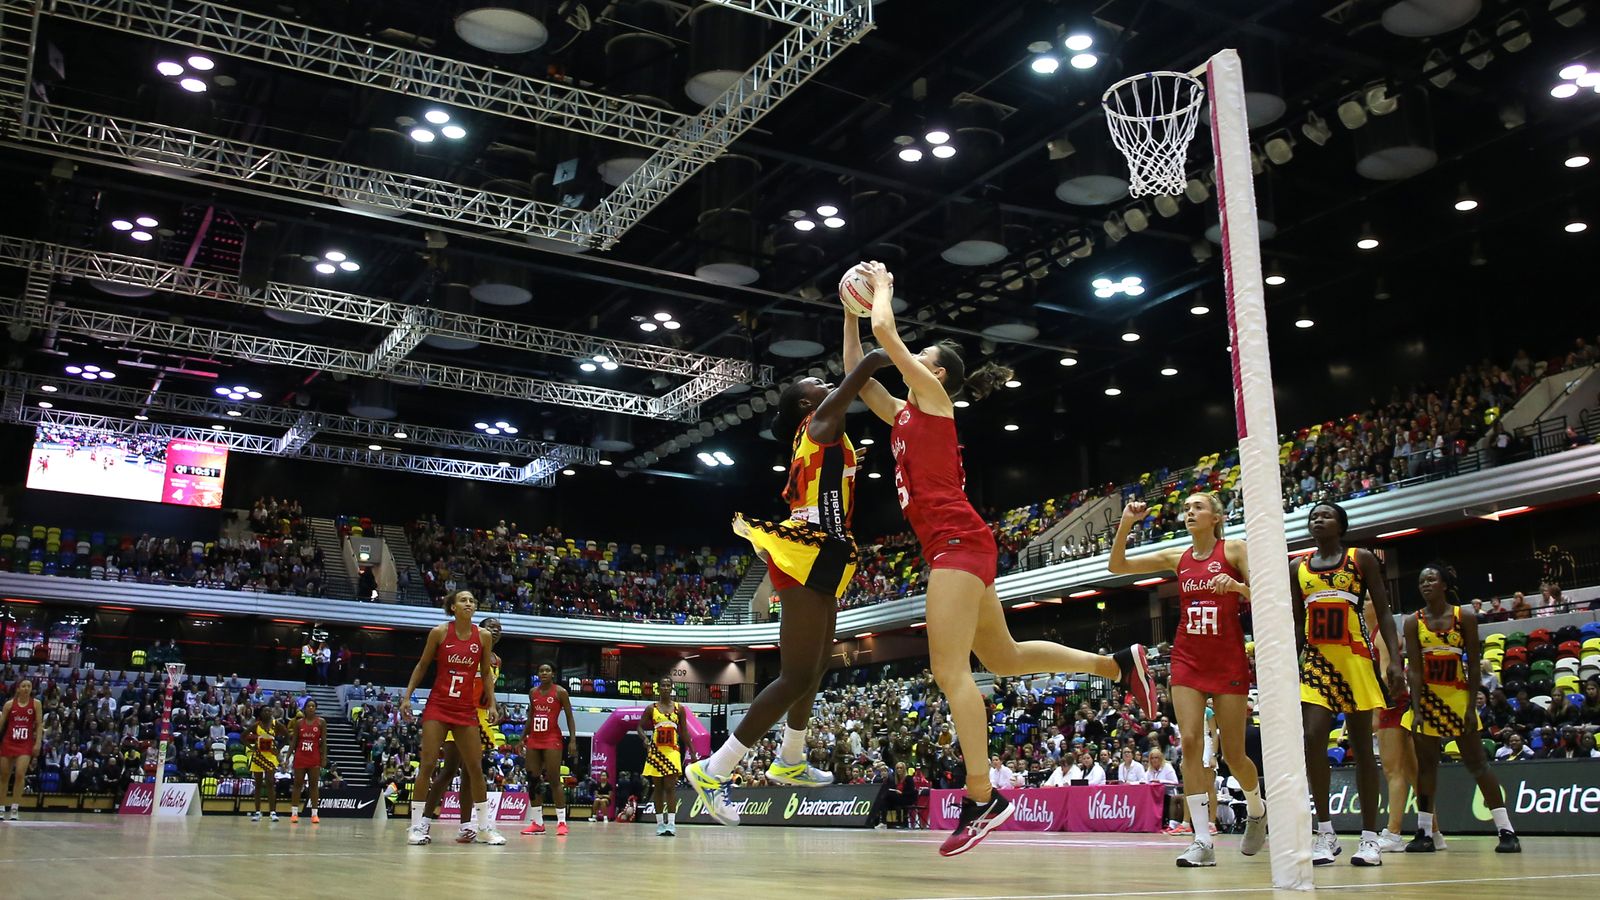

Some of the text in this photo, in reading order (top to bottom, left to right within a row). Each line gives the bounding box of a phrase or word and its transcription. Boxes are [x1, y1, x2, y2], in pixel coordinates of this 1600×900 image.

[175, 464, 216, 478] Q1 10:51
[171, 488, 184, 502] 4
[1181, 578, 1217, 594] Vitality
[1186, 606, 1218, 635] GA
[1312, 607, 1344, 640] GD
[447, 653, 475, 667] Vitality
[672, 669, 687, 677] 209
[1428, 659, 1458, 682] WD
[448, 675, 464, 698] C
[533, 717, 548, 732] GD
[12, 727, 29, 740] WD
[656, 729, 674, 744] GA
[301, 742, 314, 752] GK
[126, 786, 153, 814] Vitality
[159, 787, 187, 815] Vitality
[501, 795, 527, 814] Vitality
[1088, 789, 1136, 828] Vitality
[1011, 793, 1054, 831] Vitality
